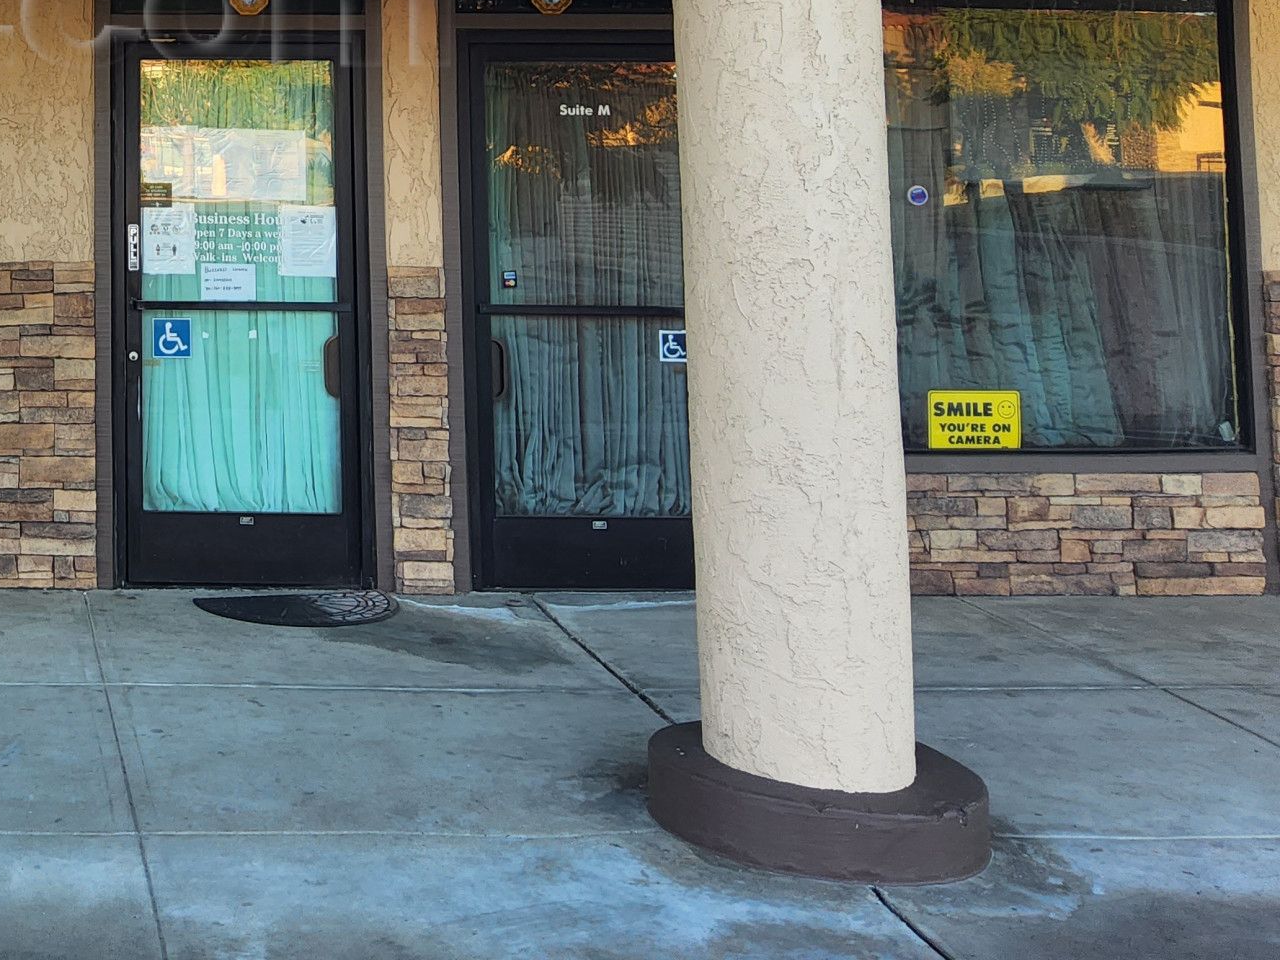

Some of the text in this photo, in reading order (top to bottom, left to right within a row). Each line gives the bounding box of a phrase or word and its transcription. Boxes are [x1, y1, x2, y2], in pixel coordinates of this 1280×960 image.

[559, 104, 611, 116] Suite M
[254, 212, 283, 225] Hou
[193, 230, 216, 240] pen
[219, 229, 225, 238] 7
[227, 229, 253, 240] Days
[218, 243, 234, 251] am
[242, 252, 281, 263] Welco
[933, 402, 993, 417] SMILE
[939, 423, 1011, 433] YOU'RE ON
[948, 435, 1001, 445] CAMERA
